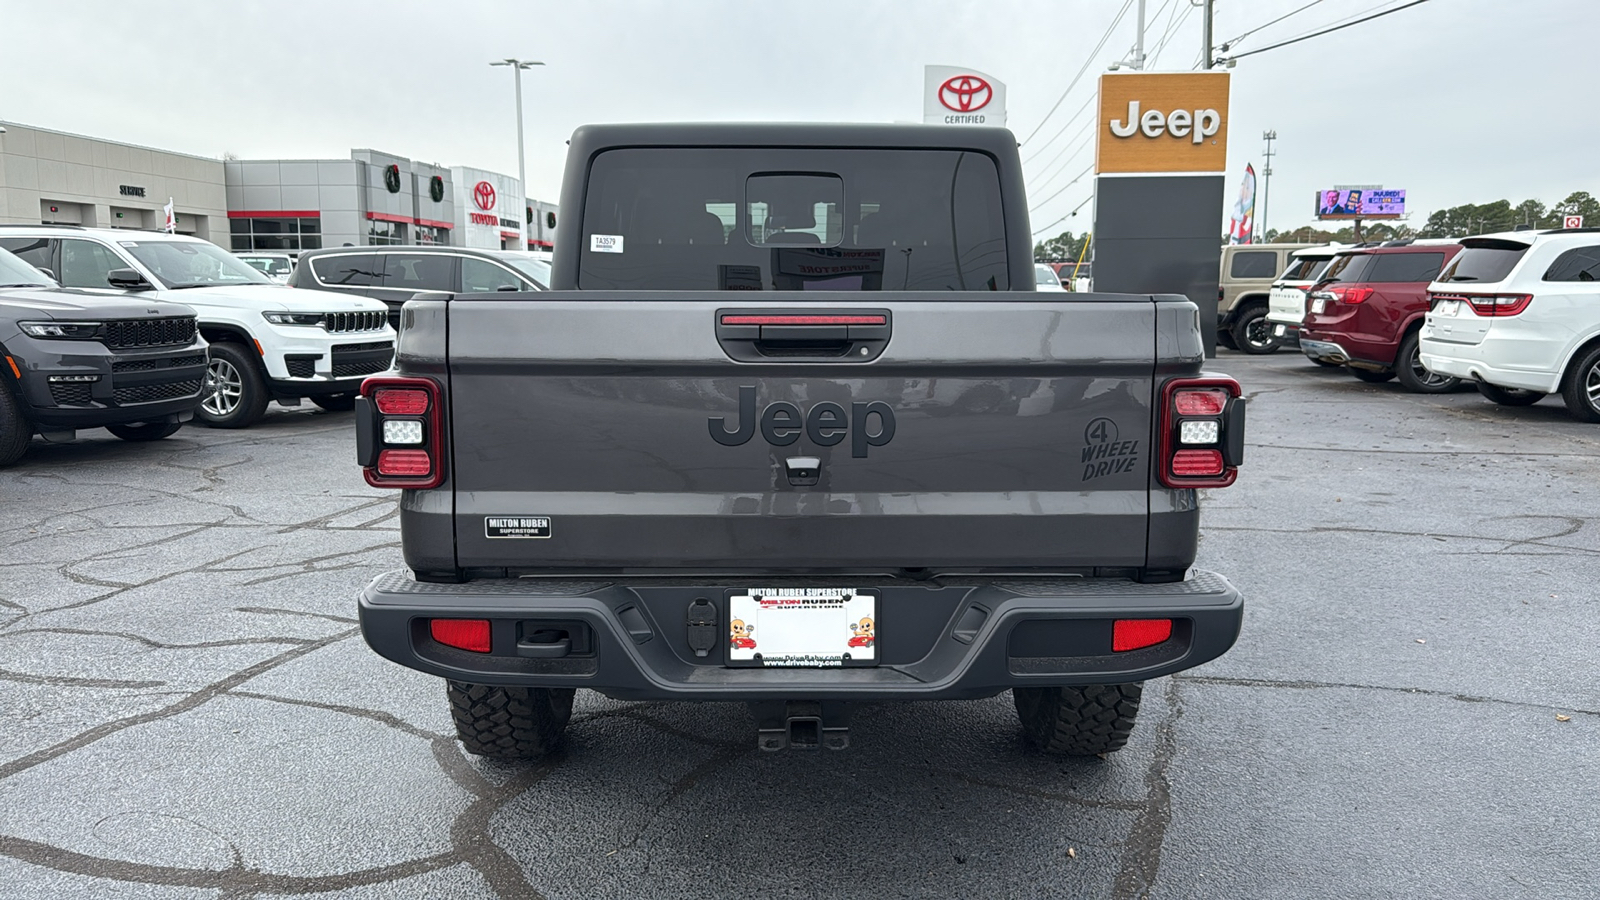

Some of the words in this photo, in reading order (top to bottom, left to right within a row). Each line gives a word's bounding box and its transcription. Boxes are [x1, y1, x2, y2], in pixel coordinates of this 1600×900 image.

[944, 115, 985, 124] CERTIFIED
[1109, 100, 1220, 144] Jeep
[119, 185, 146, 197] SERVICE
[470, 212, 498, 226] TOYOTA
[595, 237, 616, 245] TA3579
[707, 385, 896, 459] Jeep
[1090, 421, 1108, 443] 4
[1081, 440, 1139, 463] WHEEL
[1081, 457, 1138, 481] DRIVE
[489, 519, 519, 527] MILTON
[520, 519, 548, 527] RUBEN
[748, 588, 777, 596] MILTON
[778, 588, 805, 596] RUBEN
[806, 588, 857, 596] SUPERSTORE
